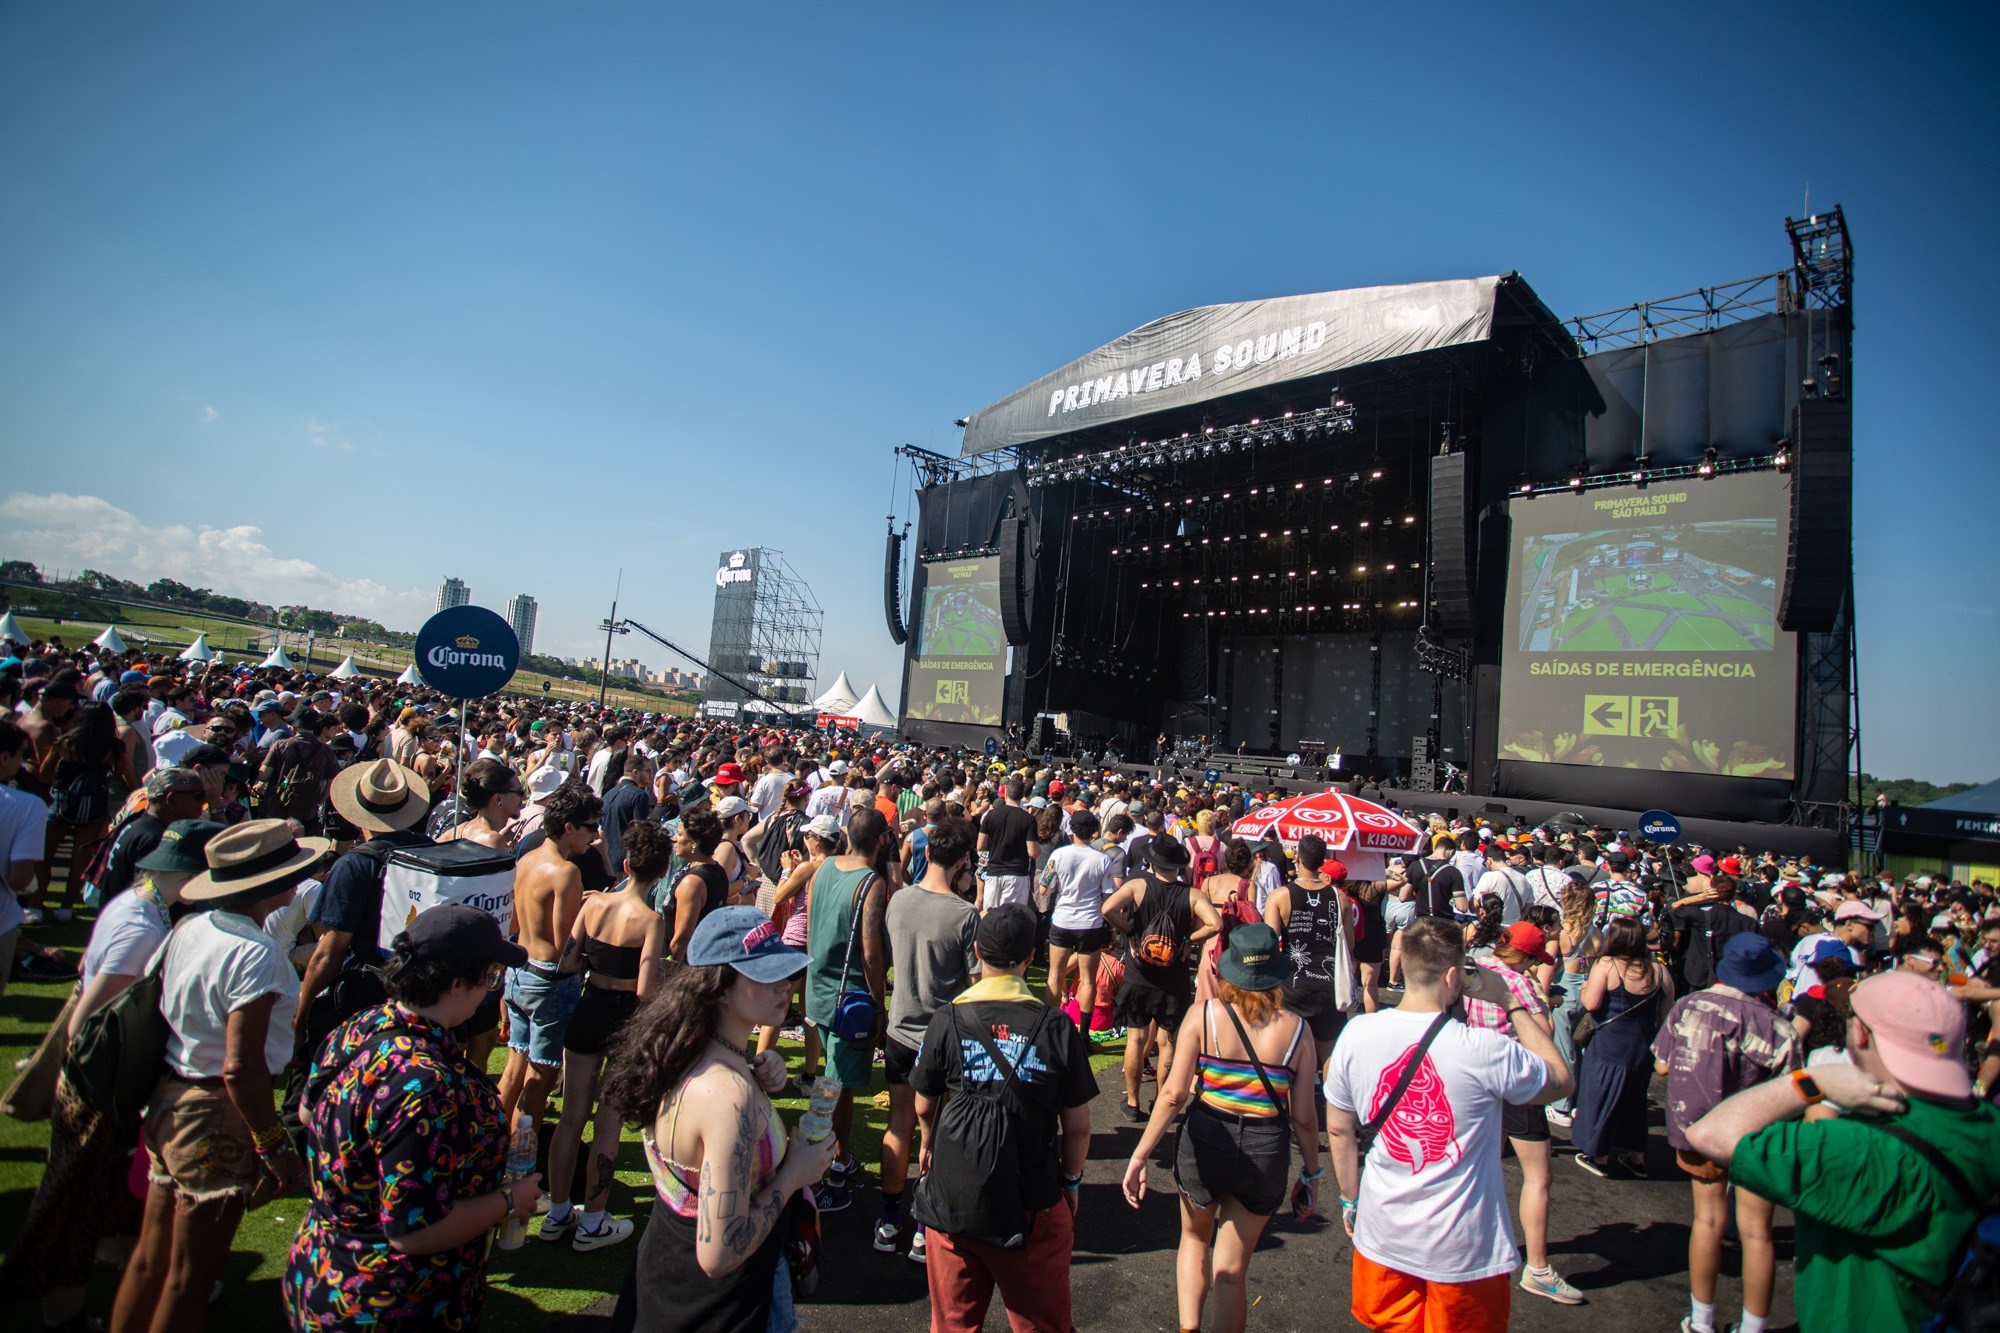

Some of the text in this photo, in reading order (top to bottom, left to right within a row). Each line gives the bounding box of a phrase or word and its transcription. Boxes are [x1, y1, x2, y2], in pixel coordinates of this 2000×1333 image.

[1048, 320, 1328, 417] PRIMAVERA SOUND
[1594, 492, 1687, 510] PRIMAVERA SOUND
[1612, 504, 1667, 519] SÃO PAULO
[716, 566, 752, 588] Corona
[428, 645, 506, 671] Corona
[920, 659, 993, 671] SAÍDAS DE EMERGÊNCIA
[1529, 659, 1756, 678] SAÍDAS DE EMERGÊNCIA
[1235, 823, 1263, 834] KIBON
[1644, 824, 1677, 834] Corona
[1956, 819, 2000, 834] FEMIN
[1367, 832, 1408, 848] KIBON
[409, 889, 421, 902] 012
